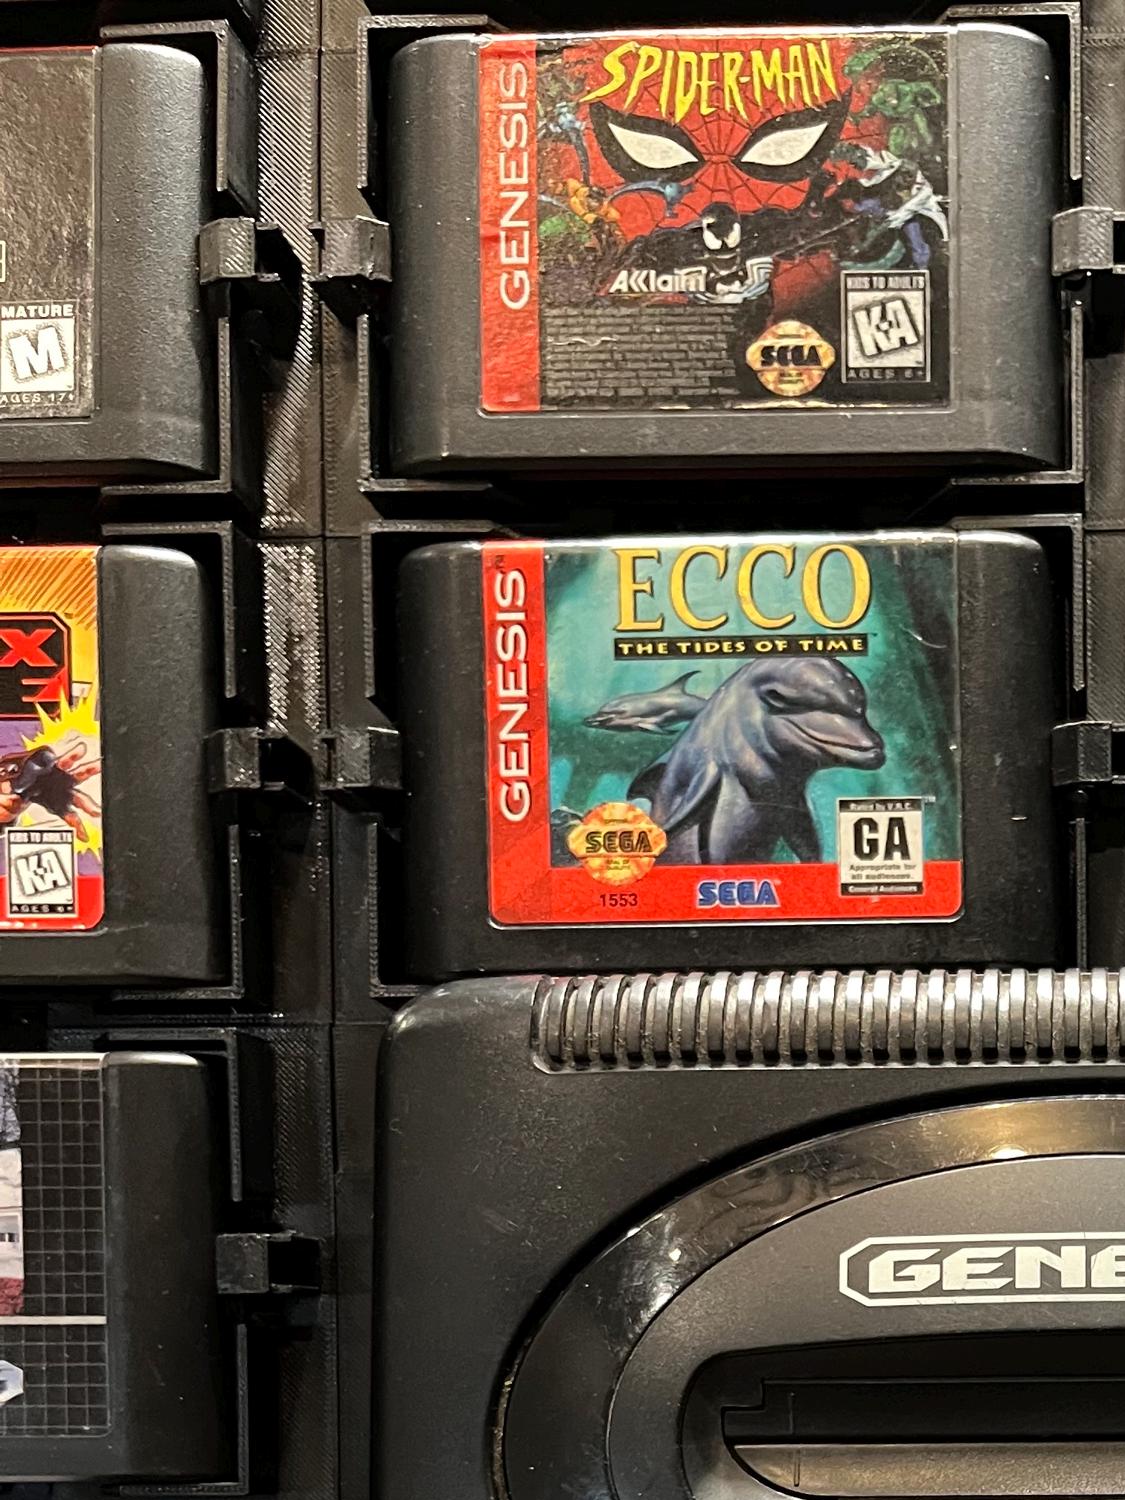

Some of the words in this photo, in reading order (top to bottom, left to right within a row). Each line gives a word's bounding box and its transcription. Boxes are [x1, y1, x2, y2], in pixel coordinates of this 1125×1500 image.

[580, 41, 841, 126] SPIDER-MAN
[499, 61, 531, 311] GENESIS
[1, 304, 75, 319] MATURE
[8, 326, 66, 381] M
[847, 369, 895, 379] AGES
[614, 543, 873, 633] ECCO
[618, 642, 669, 655] THE
[676, 640, 746, 654] TIDES
[755, 639, 789, 652] OF
[798, 638, 865, 652] TIME
[585, 830, 653, 854] SEGA
[853, 816, 911, 861] GA
[600, 893, 638, 908] 1553
